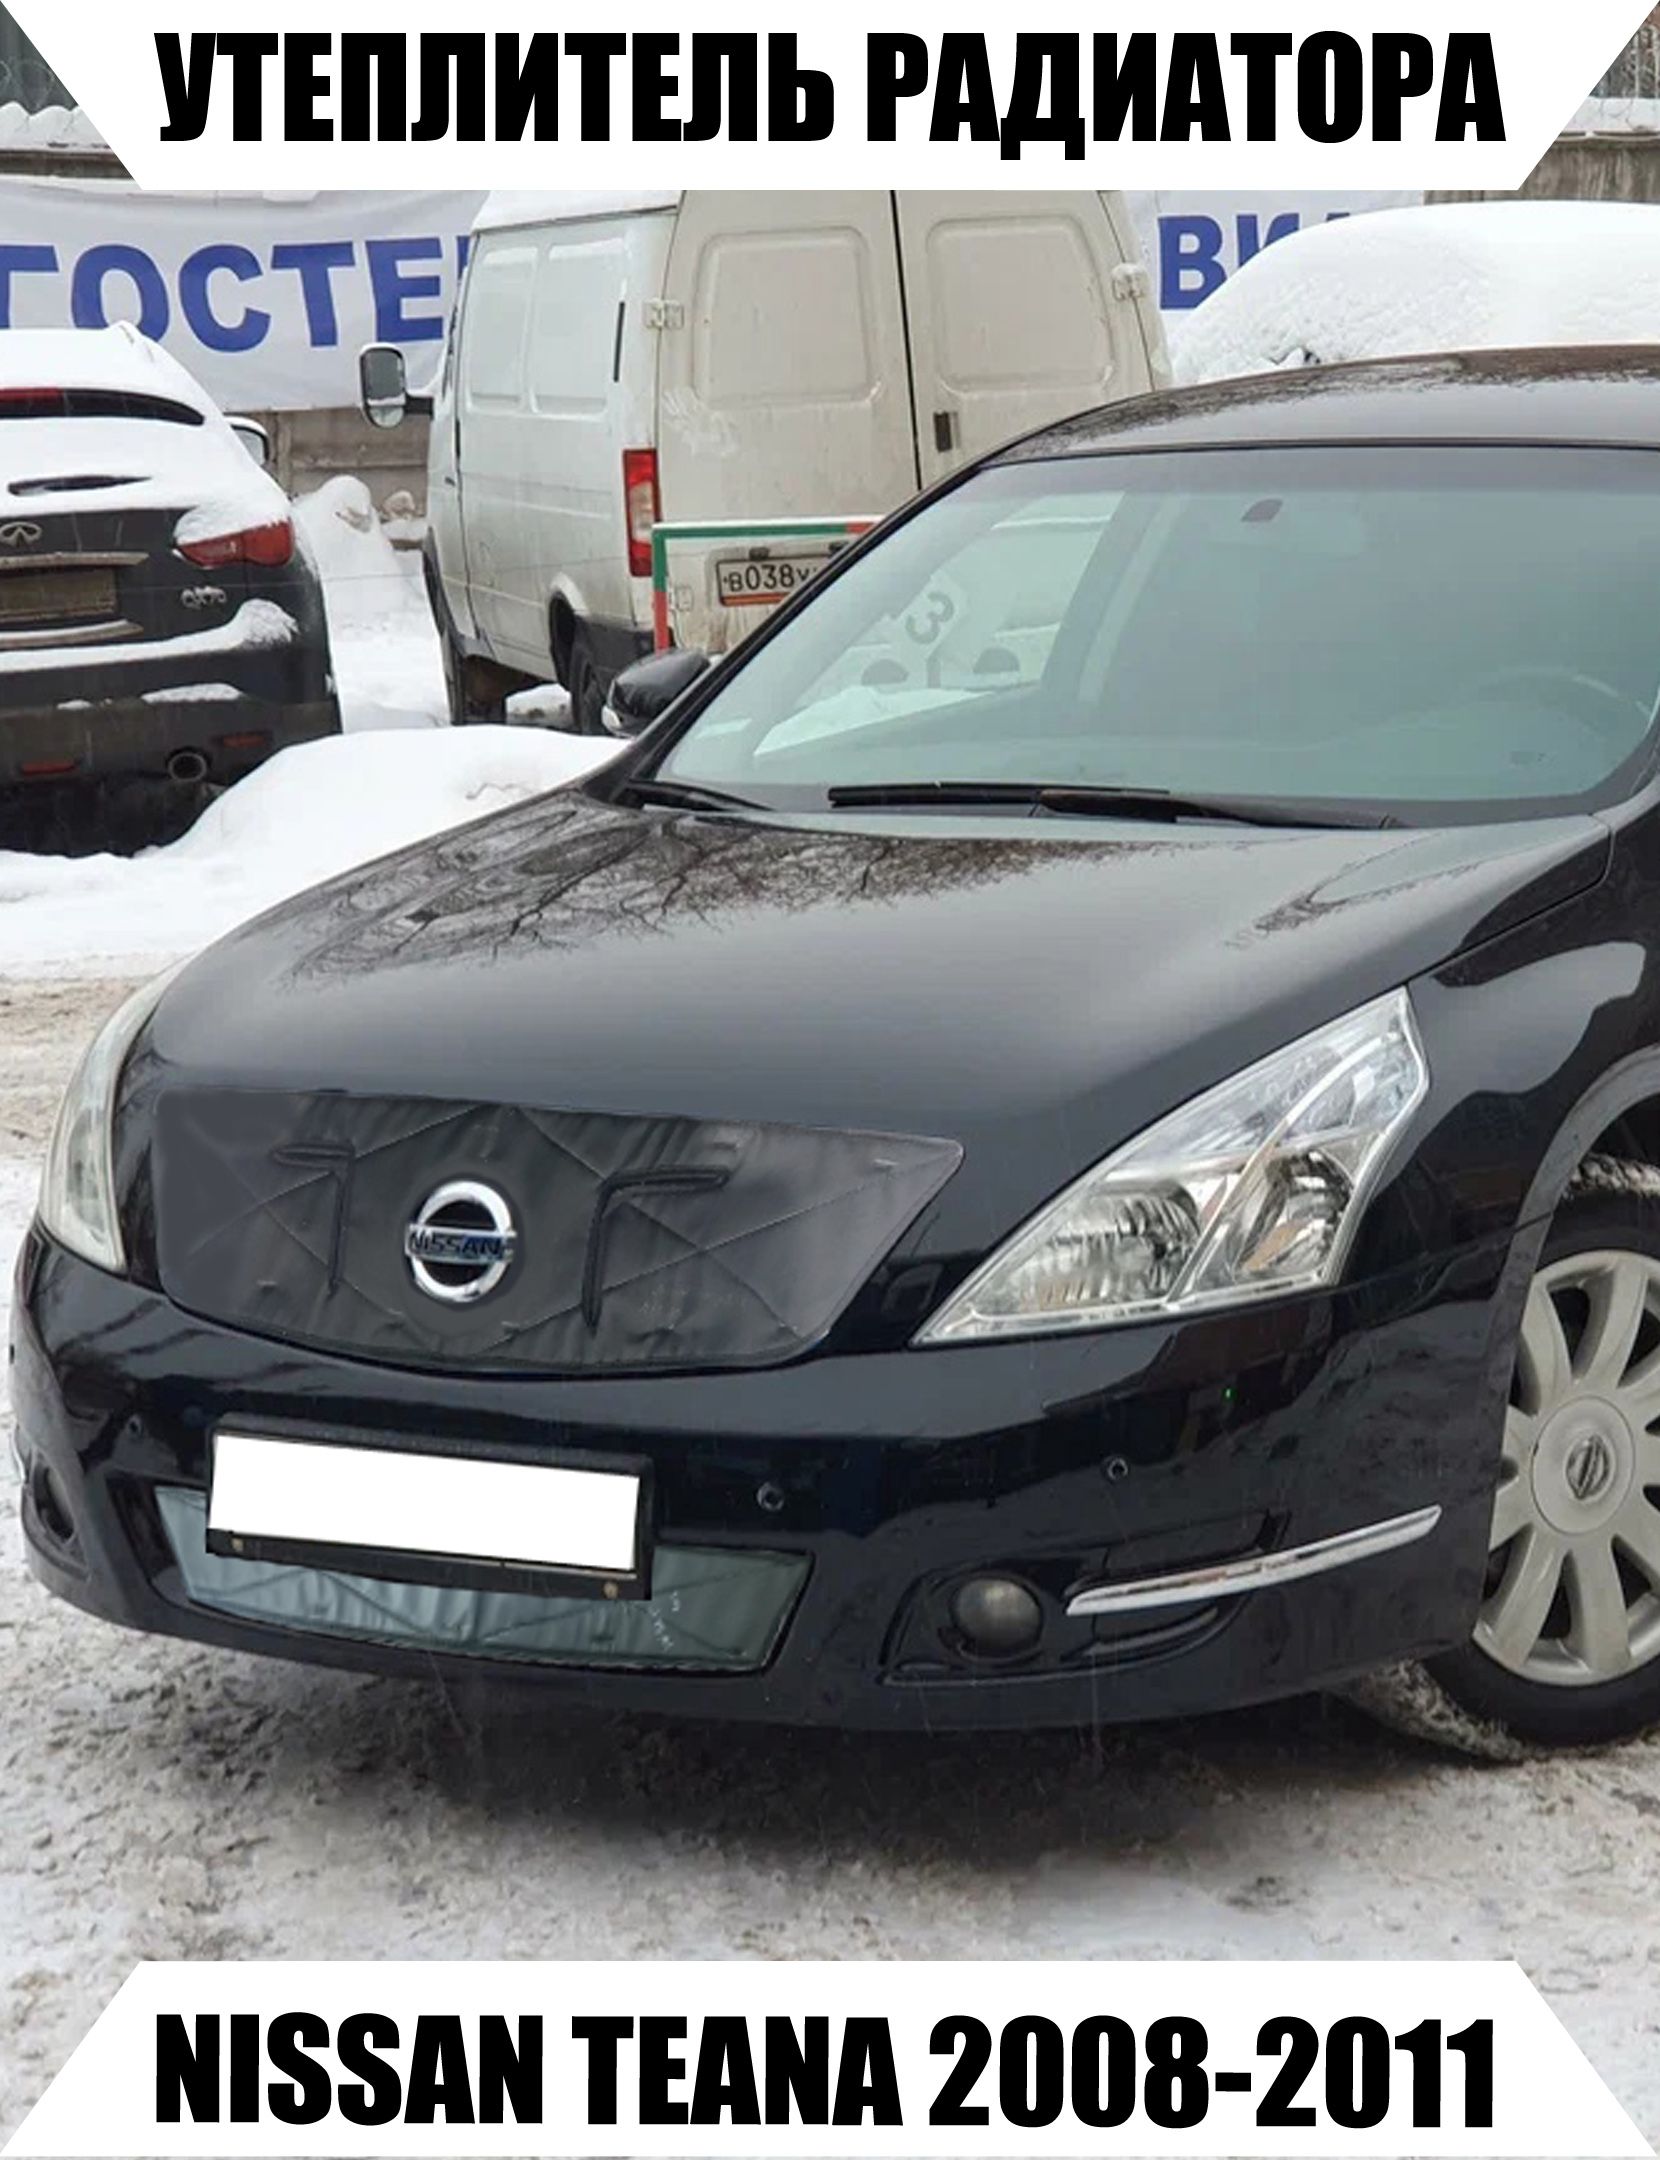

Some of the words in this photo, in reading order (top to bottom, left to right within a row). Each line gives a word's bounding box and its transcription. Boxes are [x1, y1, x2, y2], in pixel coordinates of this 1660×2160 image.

[0, 236, 470, 353] ГОСТЕ
[728, 564, 818, 592] В038У
[409, 1230, 503, 1257] NISSAN
